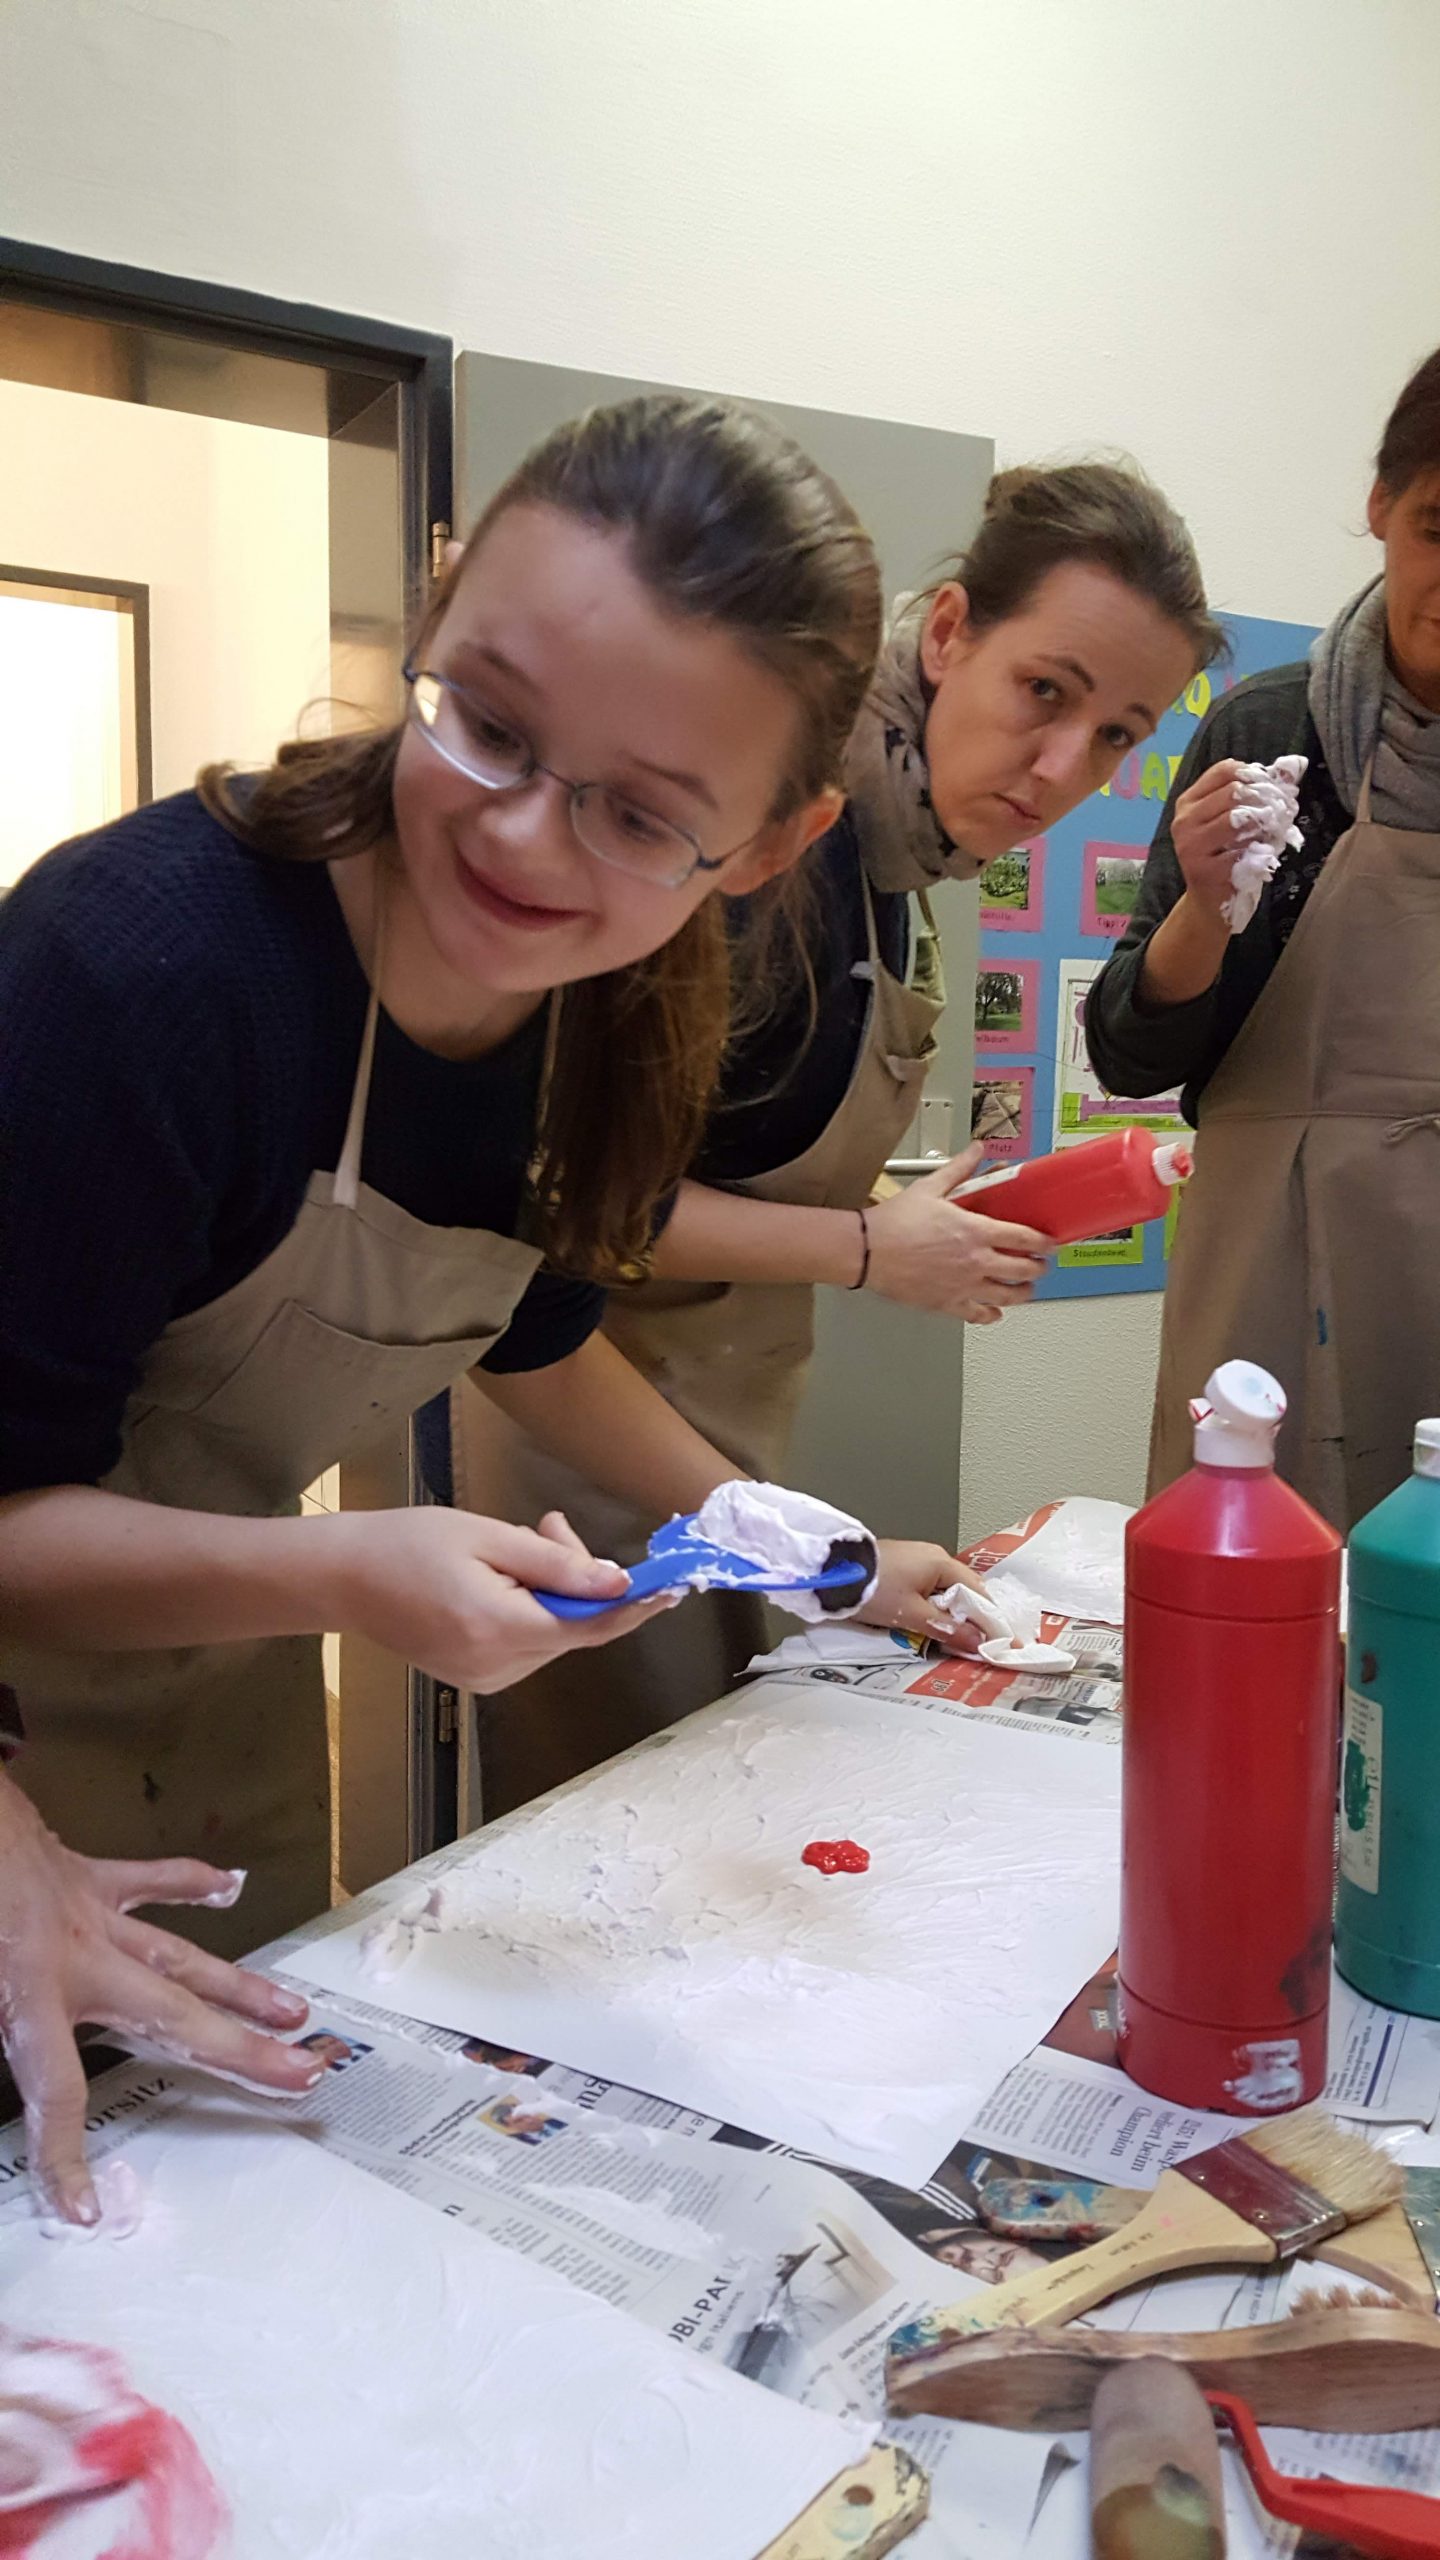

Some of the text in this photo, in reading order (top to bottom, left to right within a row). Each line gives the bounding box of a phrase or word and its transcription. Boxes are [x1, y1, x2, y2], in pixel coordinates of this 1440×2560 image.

[85, 2077, 175, 2133] orsitz
[1110, 2105, 1152, 2157] Champion
[1131, 2141, 1162, 2172] beim
